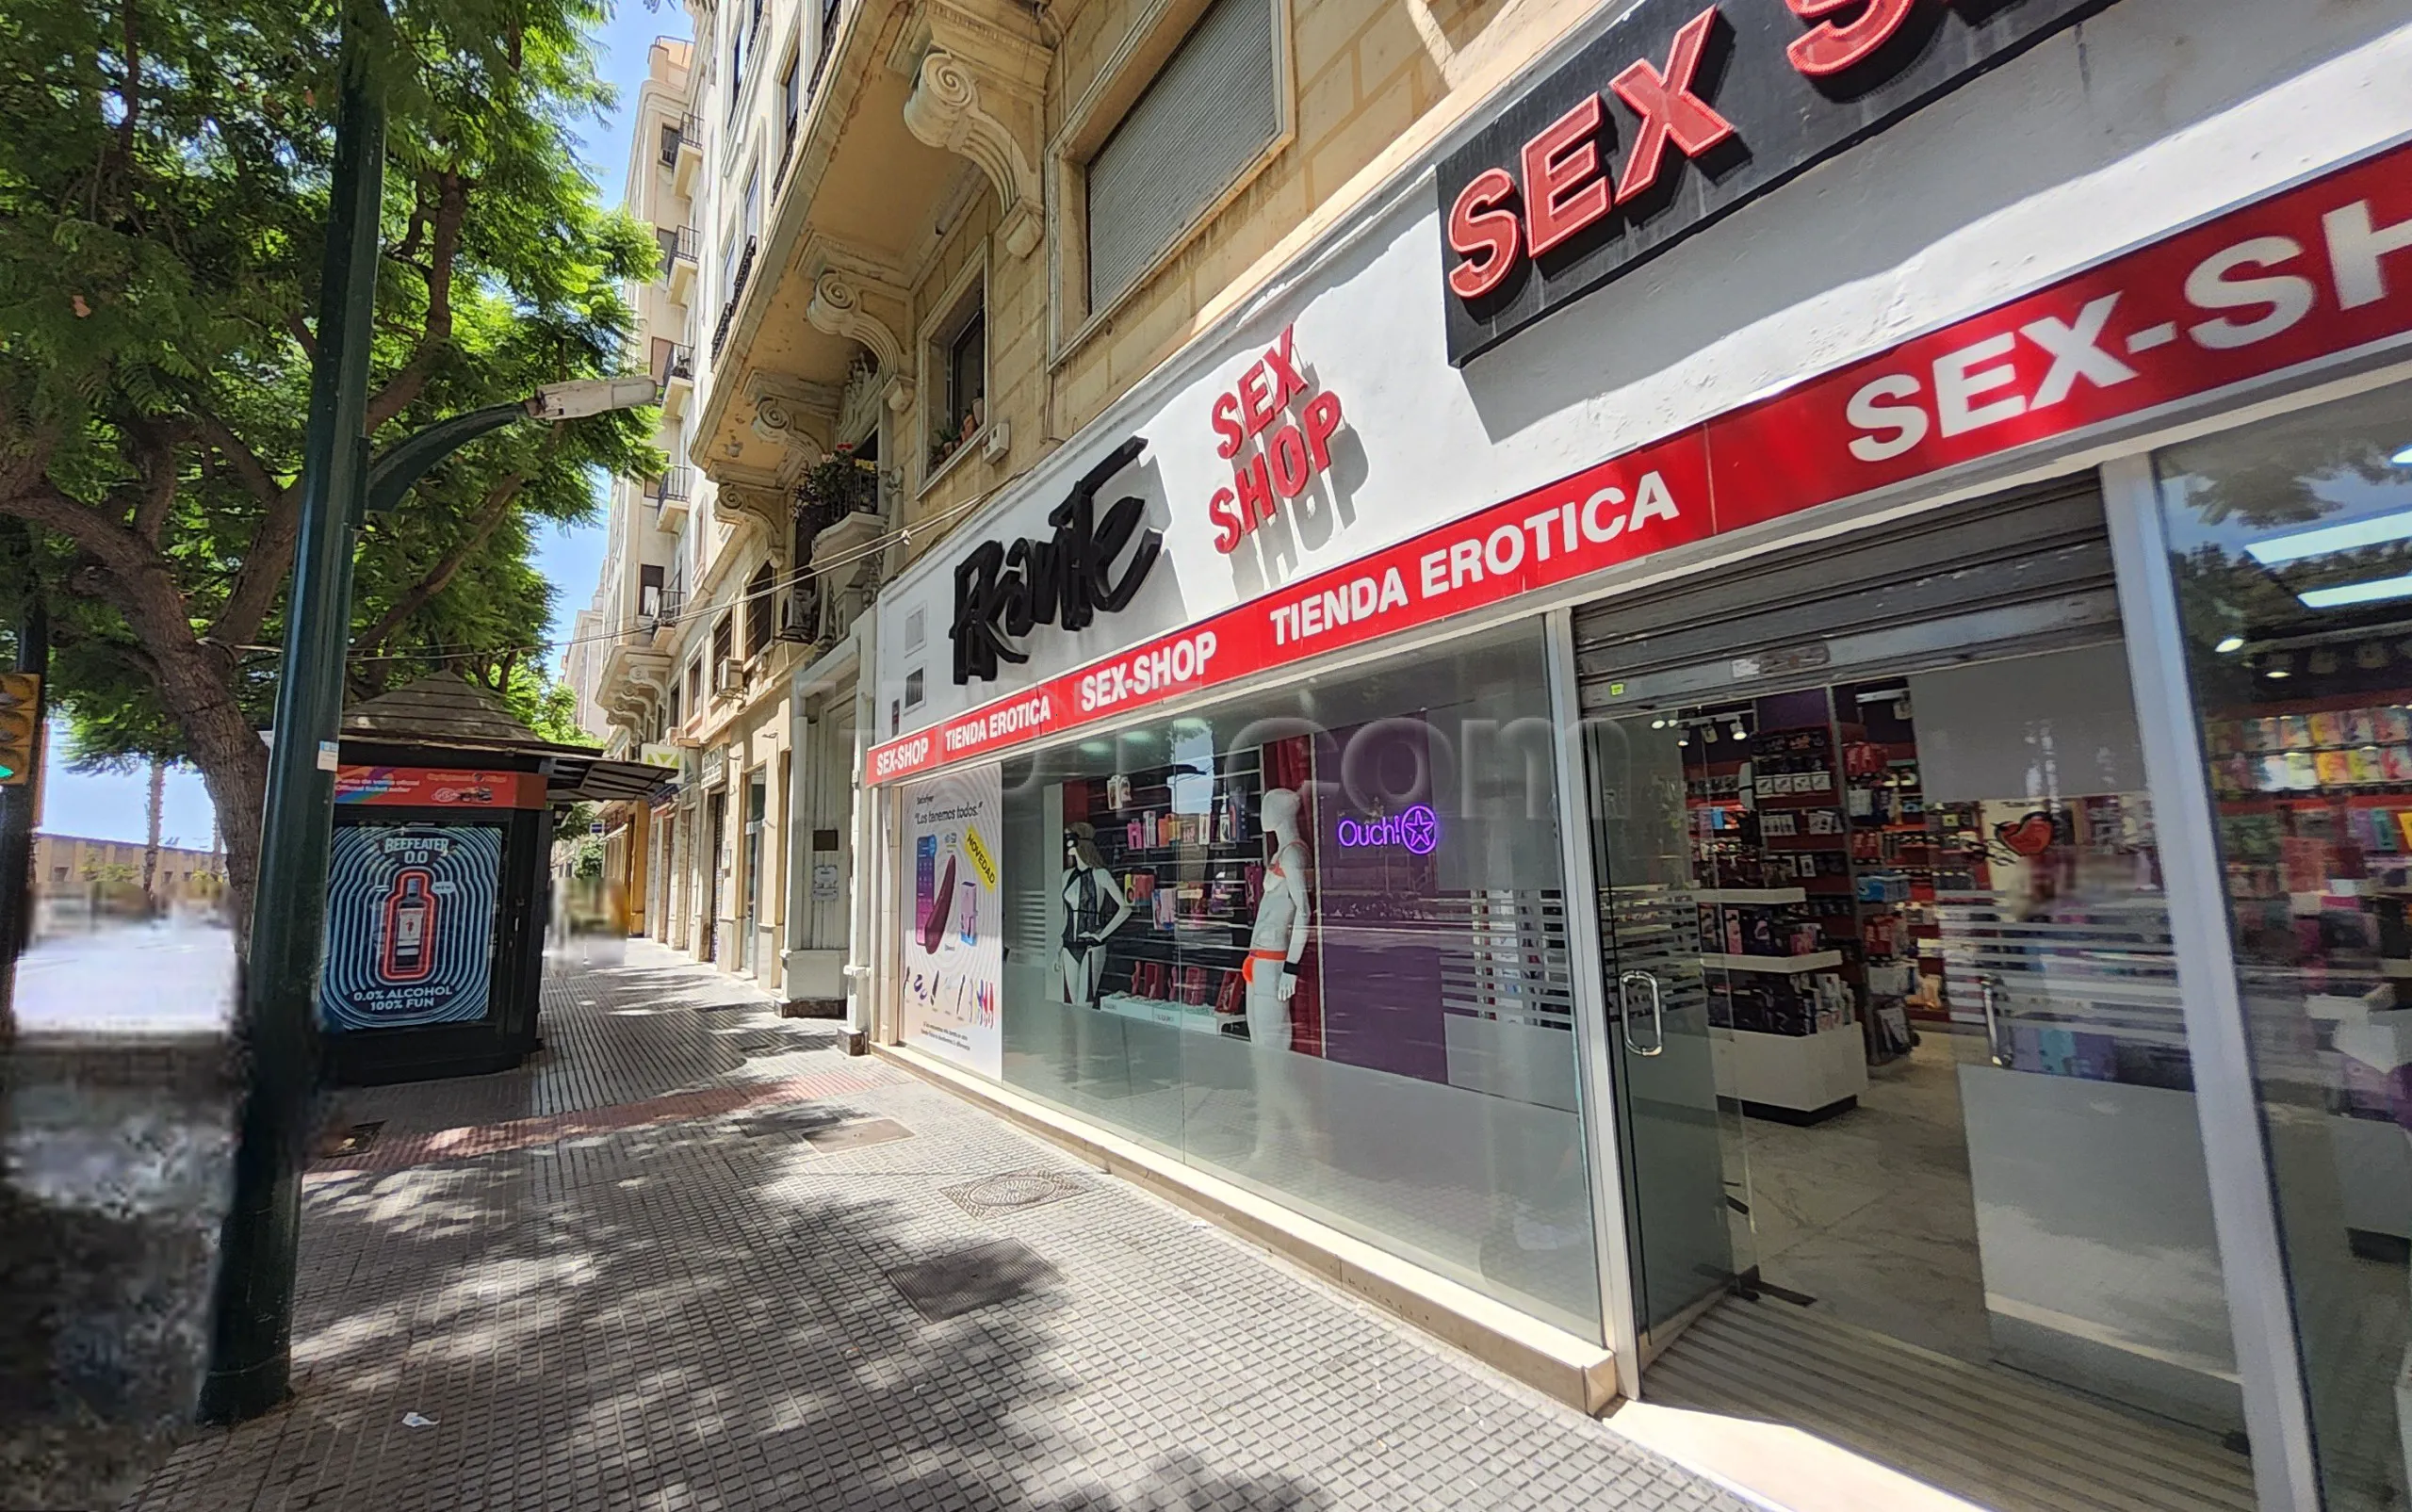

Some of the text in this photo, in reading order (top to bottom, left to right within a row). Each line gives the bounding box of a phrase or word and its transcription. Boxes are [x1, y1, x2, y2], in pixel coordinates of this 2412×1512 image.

[1448, 8, 1736, 300] SEX
[1212, 321, 1308, 460] SEX
[1209, 390, 1343, 554] SHOP
[876, 737, 929, 777] SEX-SHOP
[945, 717, 986, 752] TIENDA
[989, 694, 1051, 739] EROTICA
[1081, 630, 1217, 712] SEX-SHOP
[1269, 566, 1409, 646] TIENDA
[1420, 471, 1680, 600] EROTICA
[383, 837, 449, 857] BEEFEATER
[1338, 815, 1401, 847] Ouch!
[404, 850, 429, 864] 0.0
[967, 833, 996, 885] NOVEDAD
[353, 985, 453, 1001] 0.0% ALCOHOL
[370, 997, 434, 1012] 100% FUN
